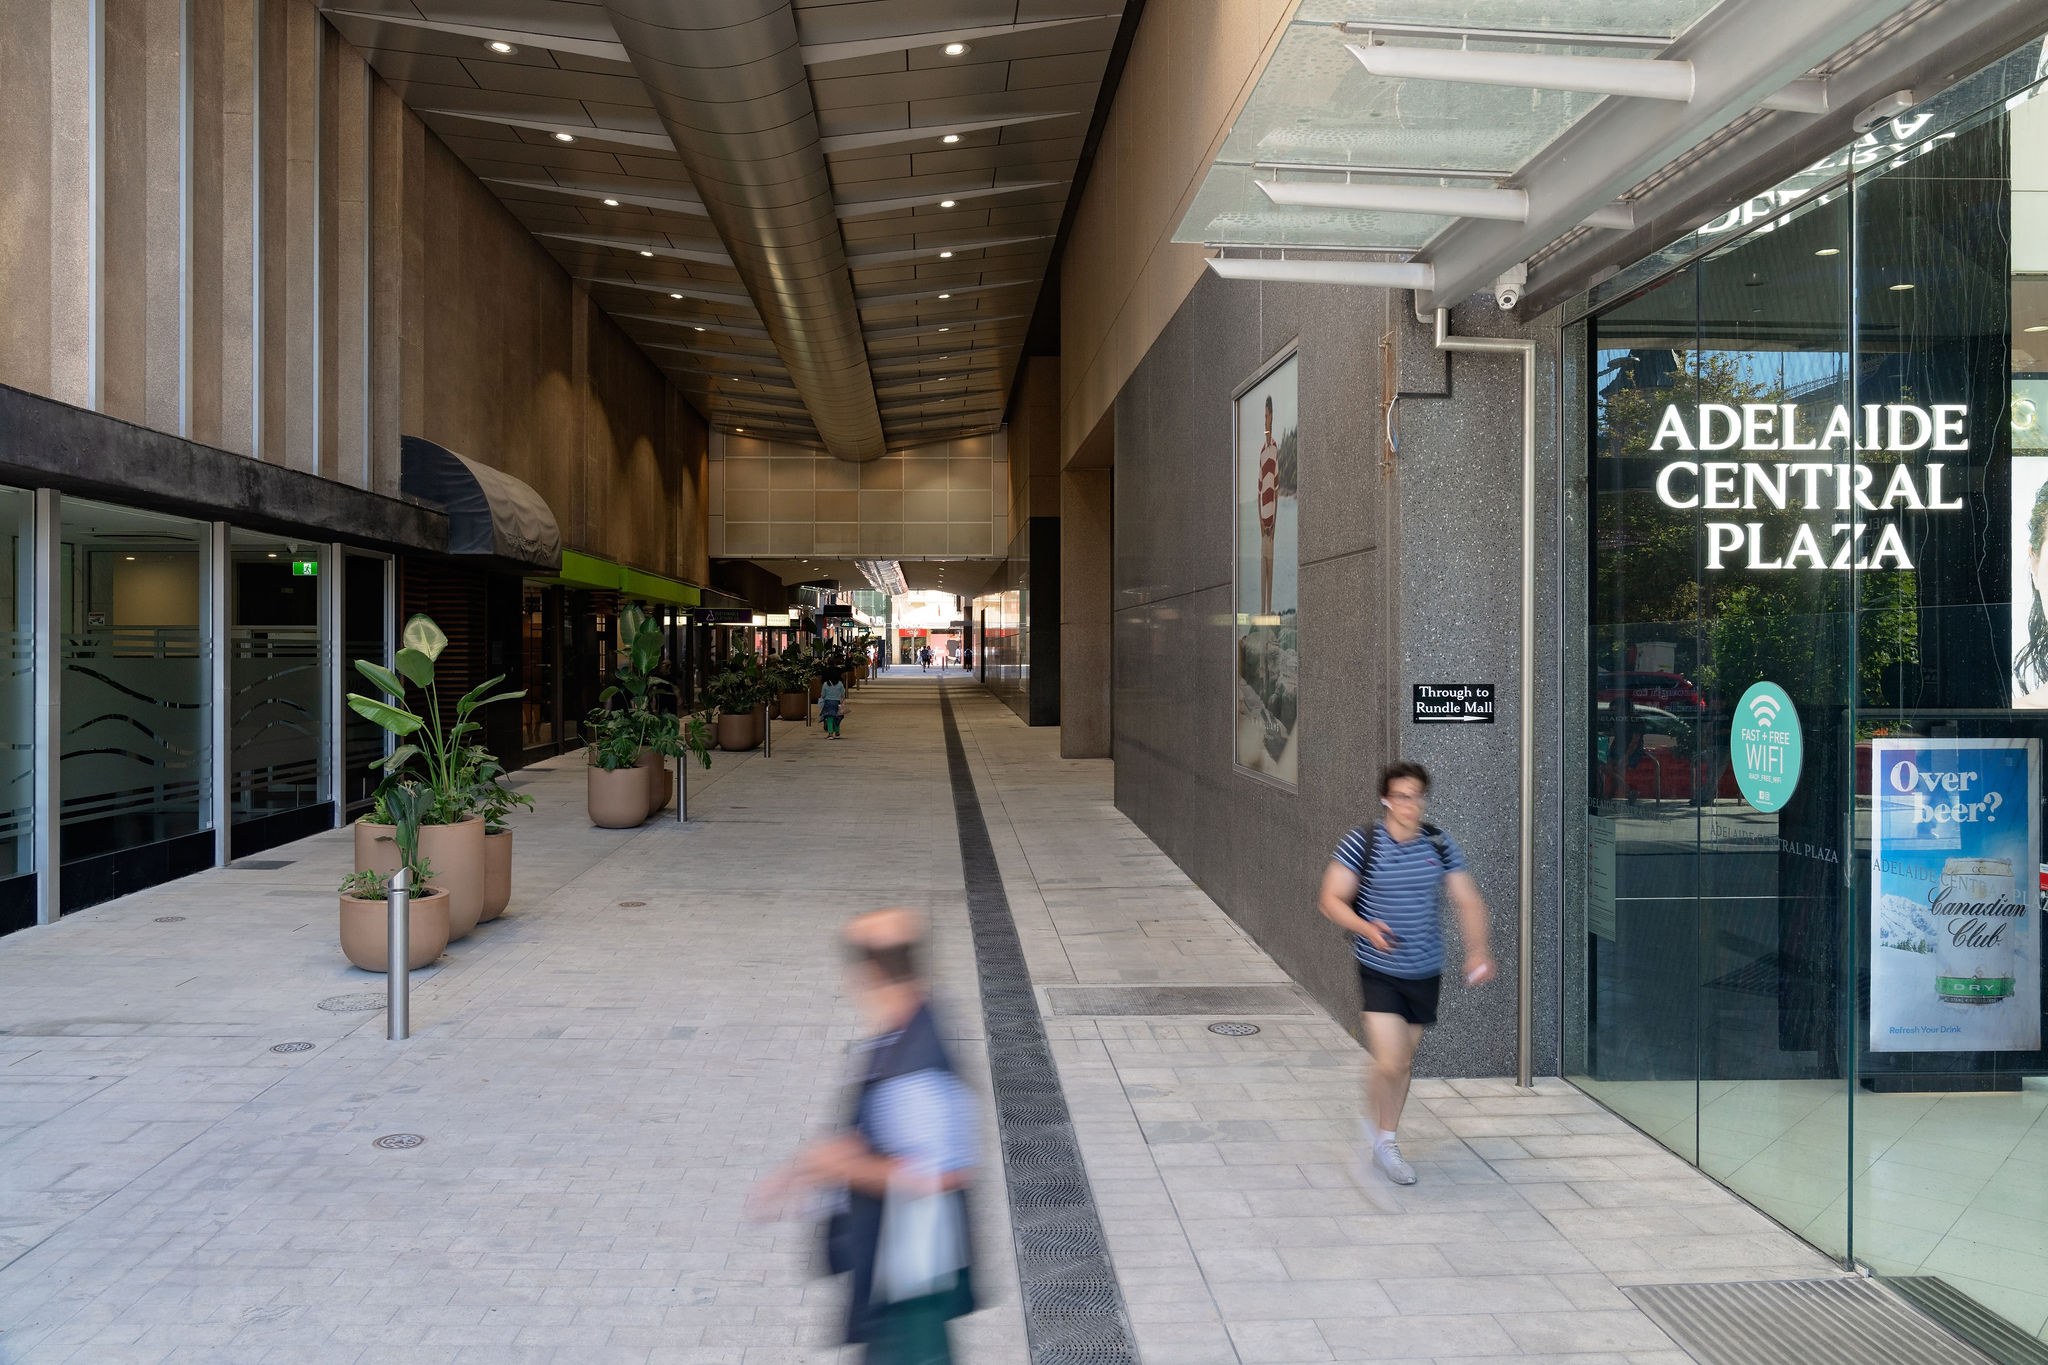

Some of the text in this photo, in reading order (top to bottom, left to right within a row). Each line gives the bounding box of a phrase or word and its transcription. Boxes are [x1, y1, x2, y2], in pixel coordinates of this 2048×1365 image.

[1649, 403, 1969, 450] ADELAIDE
[1655, 461, 1963, 510] CENTRAL
[1704, 522, 1915, 570] PLAZA
[1416, 701, 1493, 713] Rundle Mall
[1419, 685, 1489, 701] Through to
[1741, 728, 1761, 742] FAST
[1769, 730, 1790, 745] FREE
[1746, 743, 1783, 774] WIFI
[1890, 760, 1978, 792] Over
[1912, 792, 2003, 824] beer?
[1710, 824, 1754, 839] ADELAIDE
[1804, 843, 1839, 863] PLAZA
[1873, 858, 1937, 884] ADELAIDE
[1928, 887, 2027, 917] Canadian
[1948, 918, 2008, 948] Club
[1953, 984, 1995, 992] DRY
[1889, 1026, 1961, 1034] Refresh Your Drink
